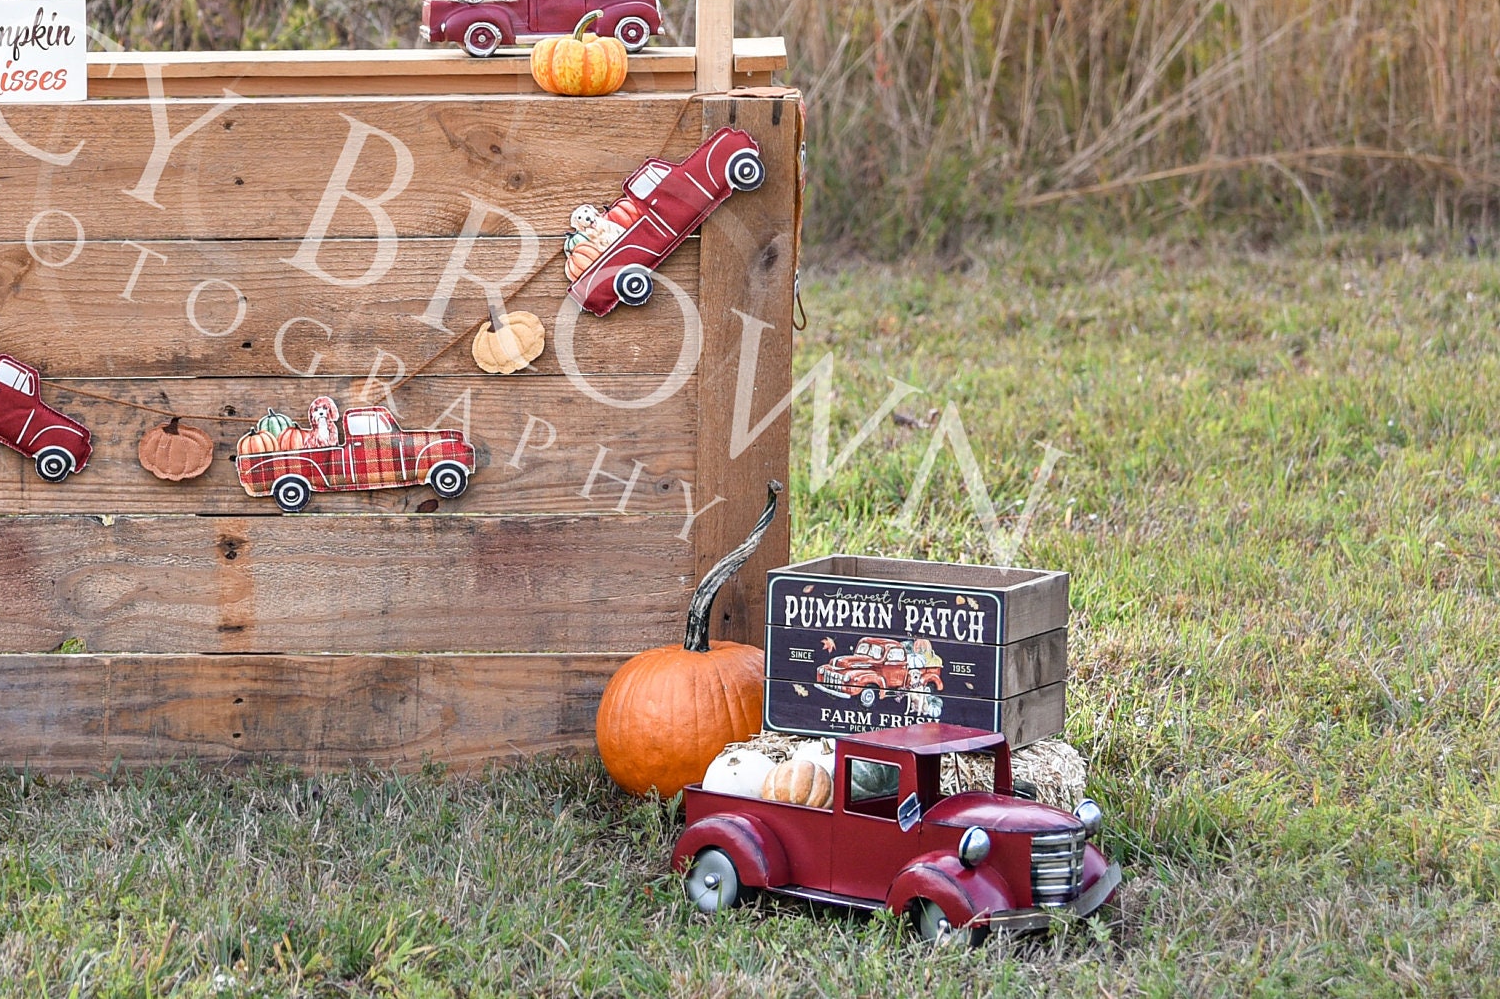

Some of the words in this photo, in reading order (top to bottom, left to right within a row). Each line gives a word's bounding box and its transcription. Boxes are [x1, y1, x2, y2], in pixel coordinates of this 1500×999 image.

[824, 587, 893, 603] harvest
[897, 590, 947, 611] farms
[784, 595, 894, 629] PUMPKIN
[904, 604, 986, 644] PATCH
[790, 650, 813, 660] SINCE
[951, 664, 972, 674] 1955
[820, 708, 873, 726] FARM
[849, 724, 867, 733] PICK
